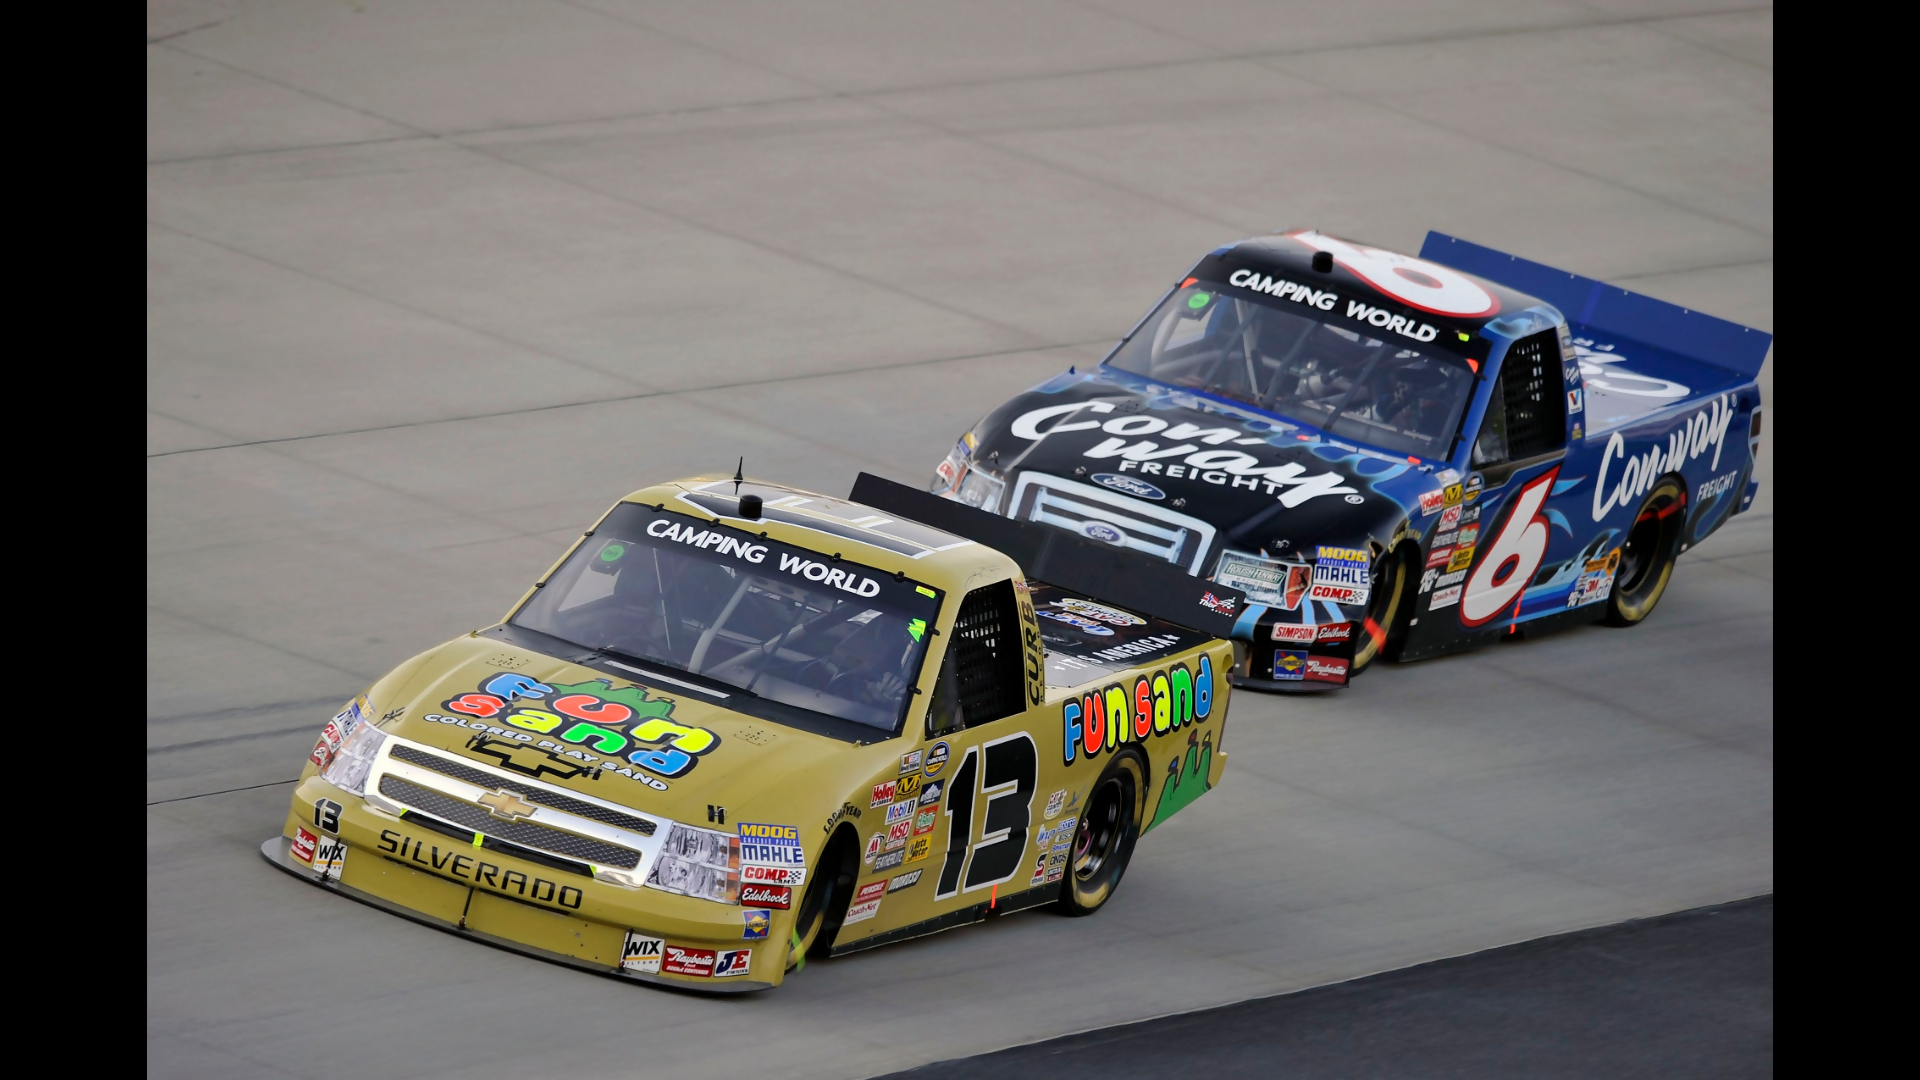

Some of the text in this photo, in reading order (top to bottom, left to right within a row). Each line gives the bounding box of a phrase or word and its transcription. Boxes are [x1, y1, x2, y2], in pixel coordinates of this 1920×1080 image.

[1229, 268, 1437, 343] CAMPING WORLD
[1083, 436, 1358, 509] way
[1118, 459, 1285, 496] FREIGHT
[1103, 475, 1153, 495] Ford
[1696, 470, 1737, 502] FREIGHT
[1443, 507, 1461, 523] MSD
[1317, 546, 1368, 562] MOOG
[1460, 463, 1561, 627] 6
[646, 519, 881, 598] CAMPING WORLD
[1225, 562, 1254, 578] ROUSH
[1315, 566, 1368, 585] MAHLE
[1313, 586, 1353, 599] COMP
[1276, 626, 1315, 640] SIMPSON
[1021, 600, 1040, 707] CURB
[1092, 636, 1176, 662] AMERICA
[423, 713, 669, 792] COLORED PLAY SAND
[872, 782, 896, 803] Holley
[313, 797, 343, 835] 13
[934, 731, 1039, 902] 13
[740, 824, 797, 839] MOOG
[888, 820, 910, 841] MSD
[319, 845, 346, 861] WIX
[741, 844, 804, 863] MAHLE
[377, 829, 584, 910] SILVERADO
[744, 867, 789, 881] COMP
[742, 887, 789, 905] Edelbrock
[626, 940, 662, 956] WIX
[716, 950, 750, 975] JE
